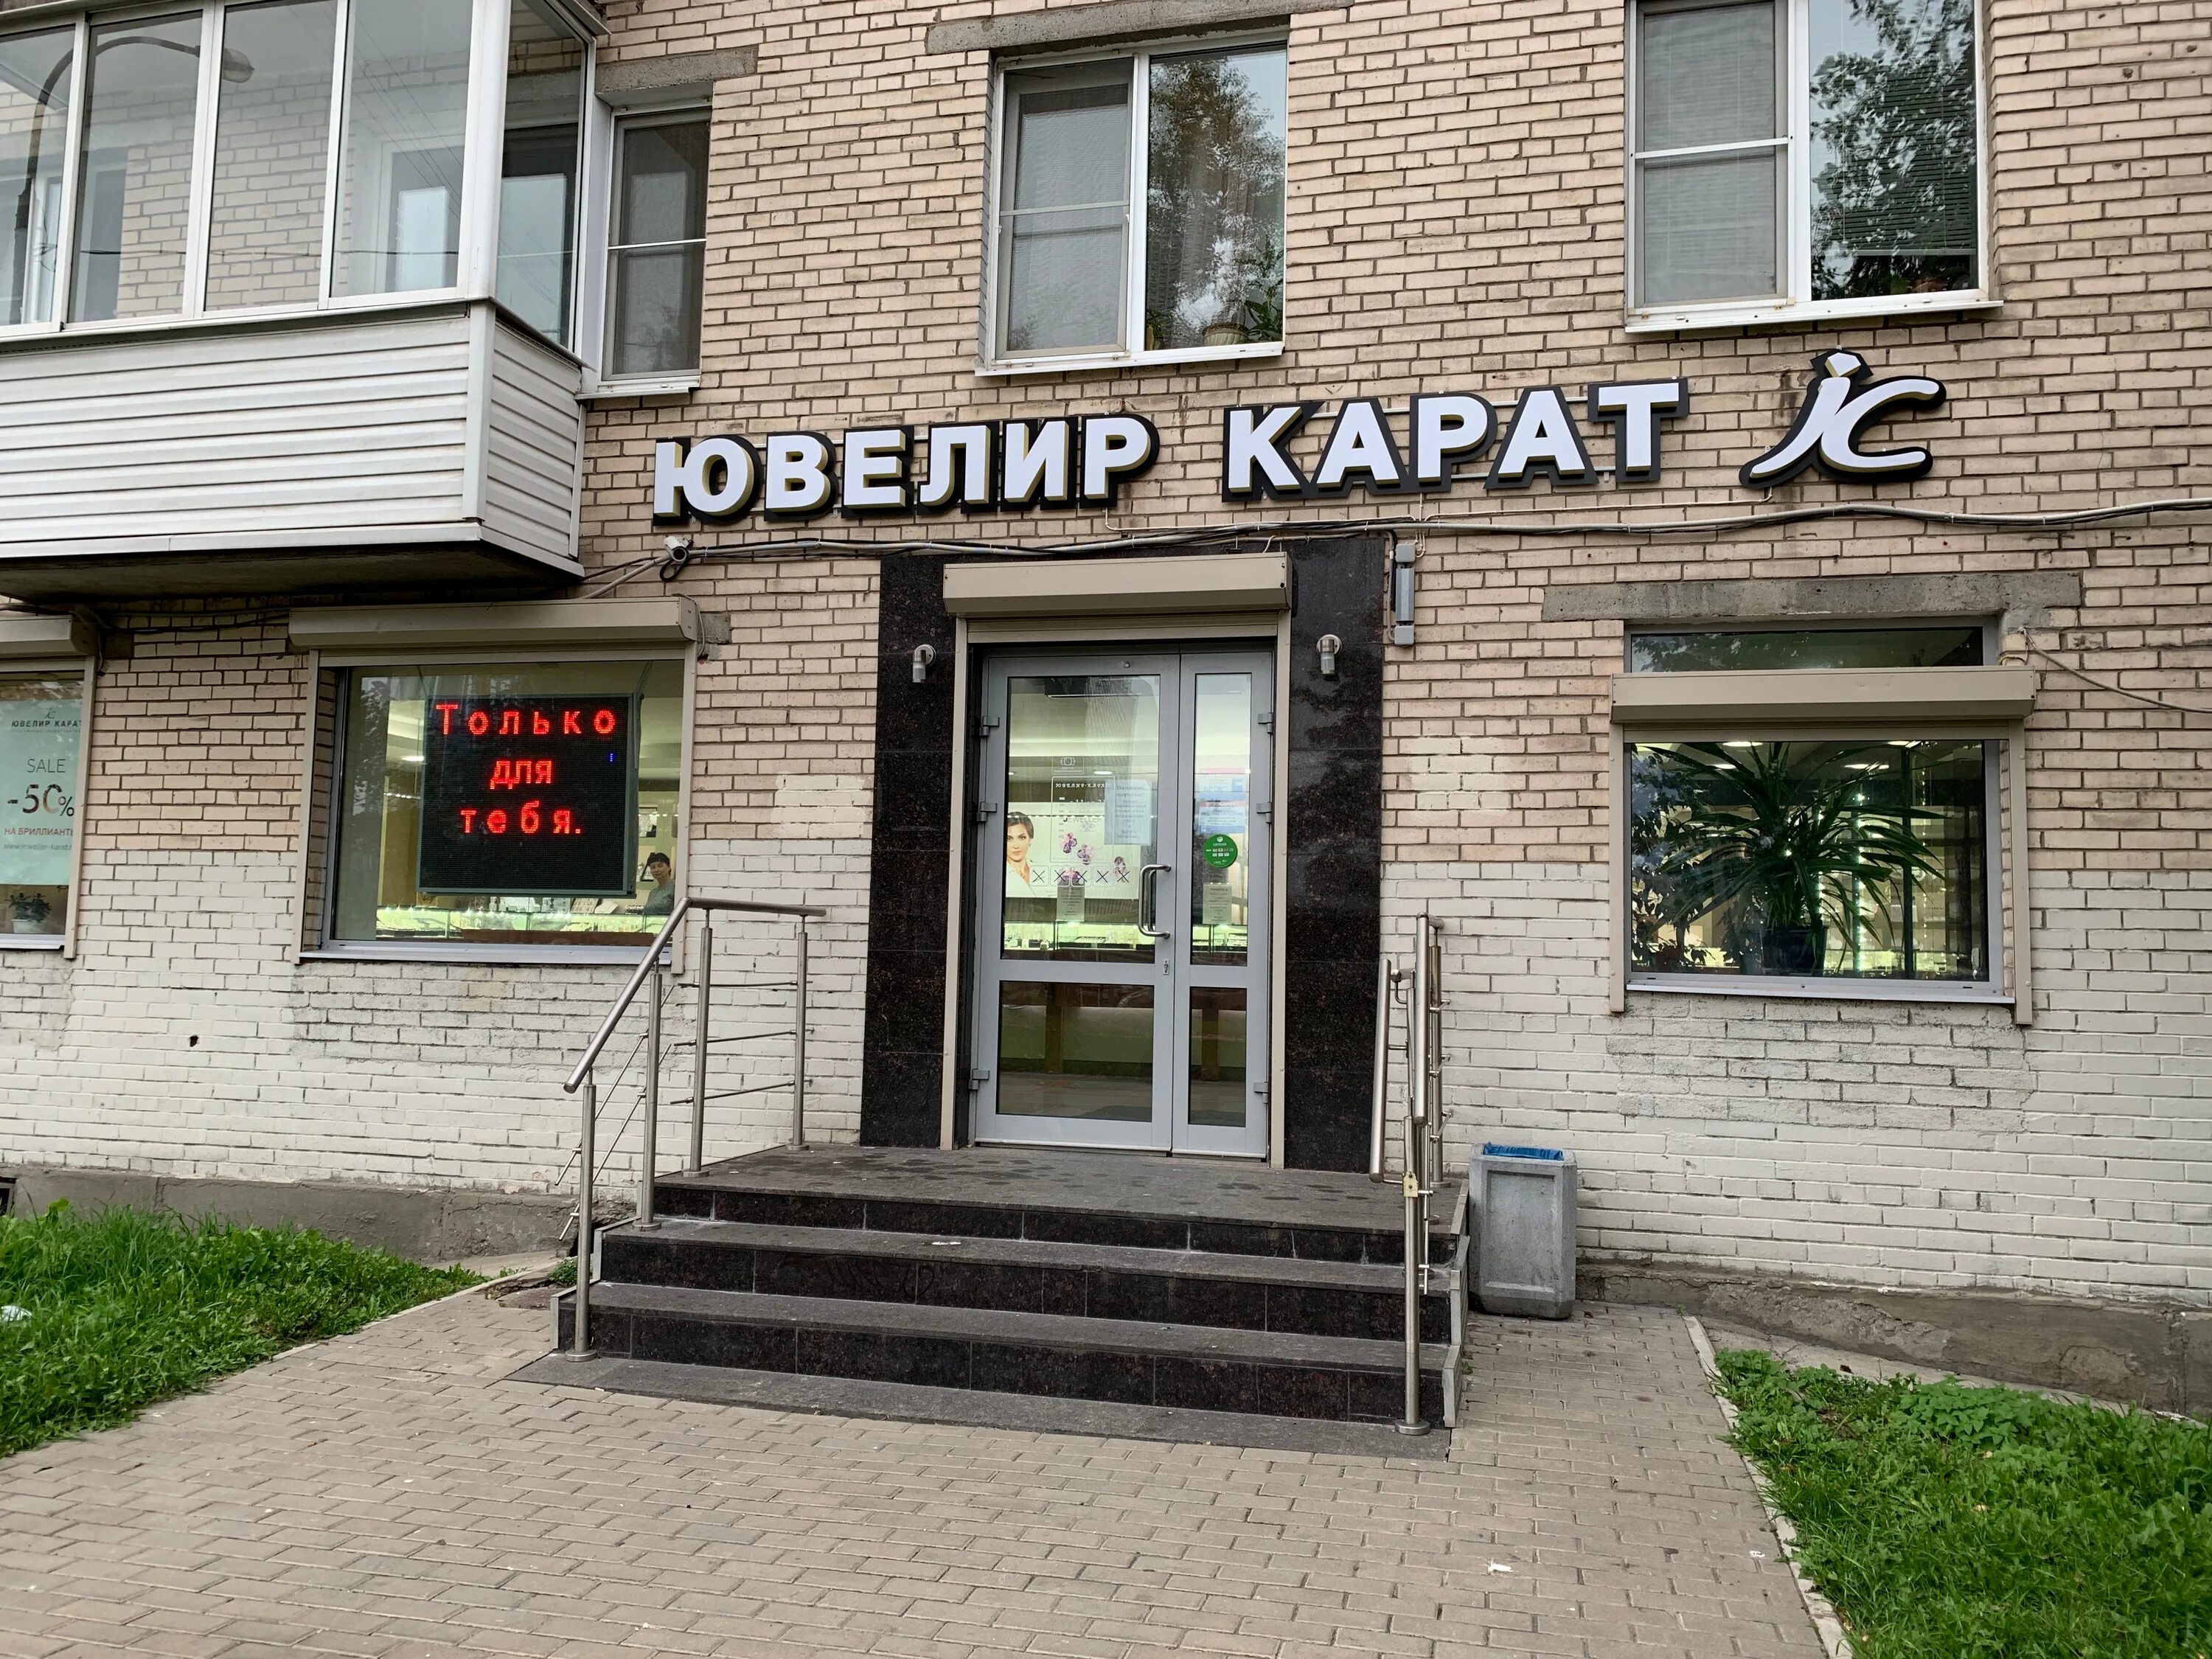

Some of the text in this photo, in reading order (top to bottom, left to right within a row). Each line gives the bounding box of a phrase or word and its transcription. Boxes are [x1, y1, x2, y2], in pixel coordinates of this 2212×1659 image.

[653, 382, 1683, 518] ЮВЕЛИР КАРАТ
[436, 703, 616, 735] Только
[27, 758, 66, 773] SALE
[490, 760, 552, 790] для
[7, 784, 74, 817] -50%
[4, 827, 15, 835] НА
[461, 800, 581, 834] тебя.
